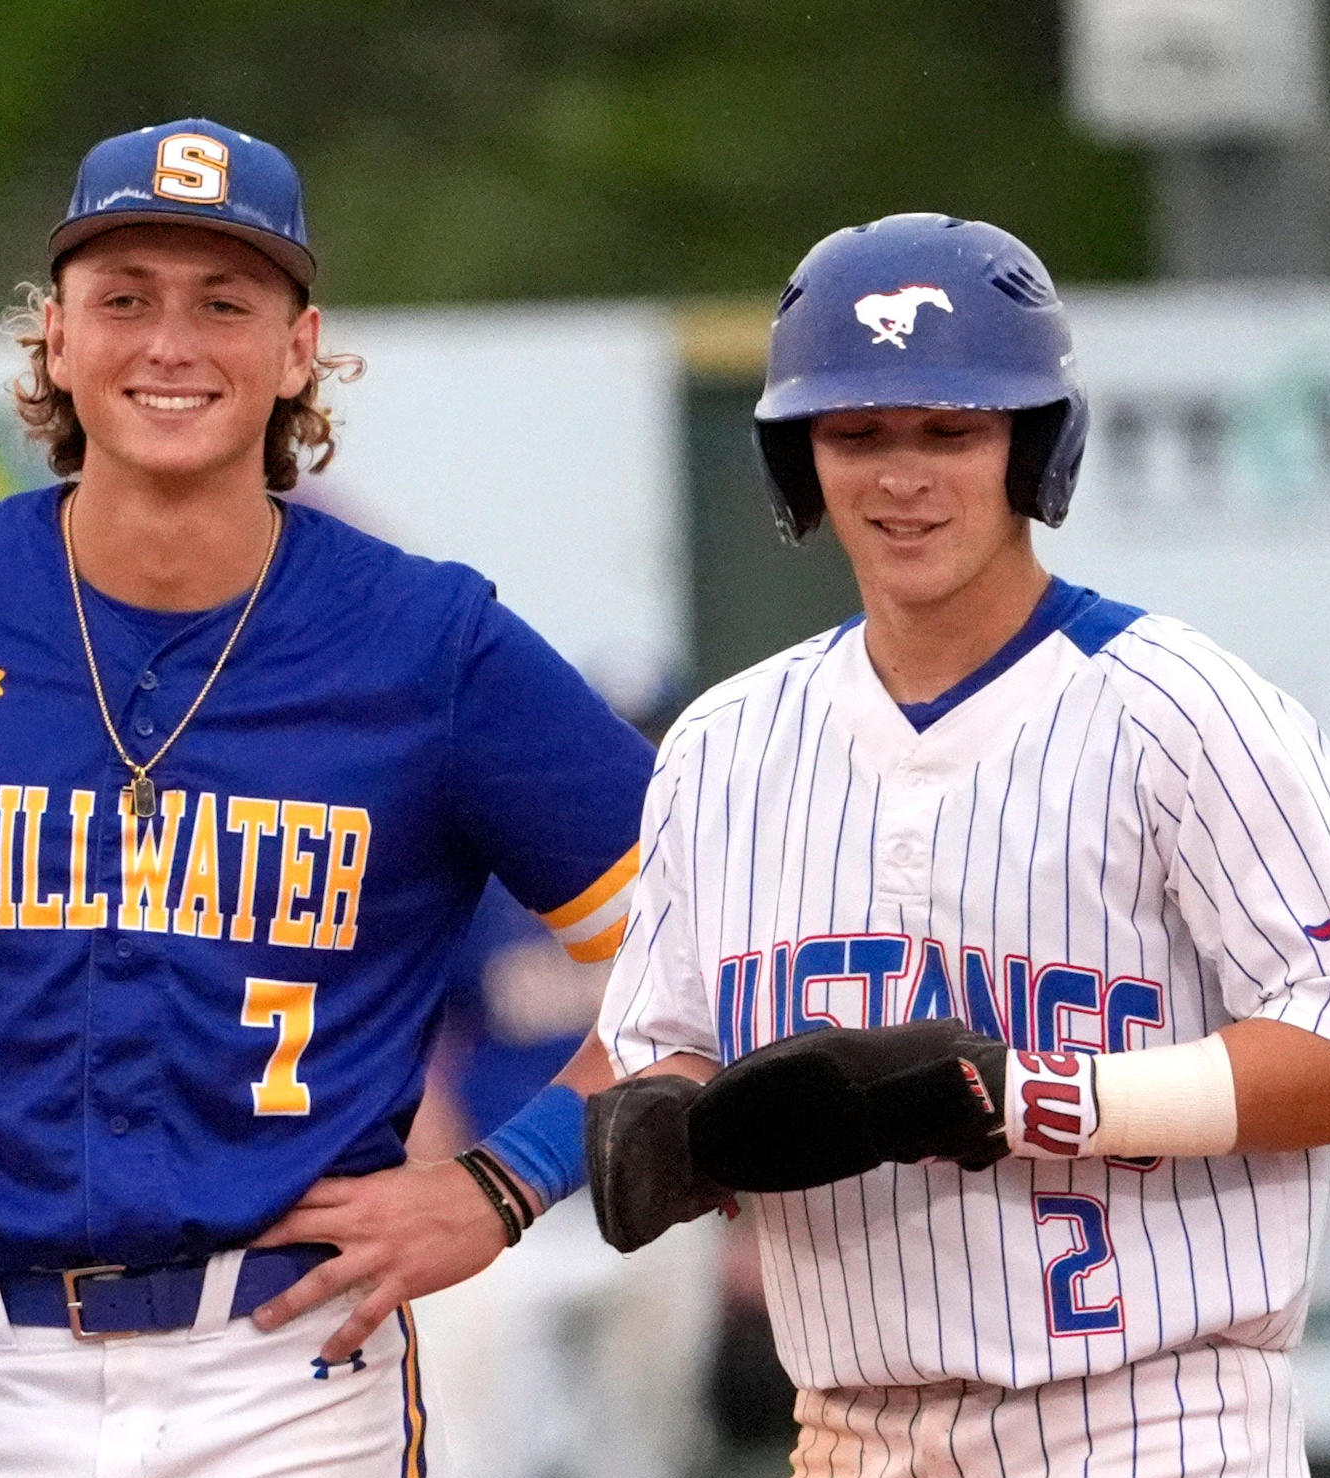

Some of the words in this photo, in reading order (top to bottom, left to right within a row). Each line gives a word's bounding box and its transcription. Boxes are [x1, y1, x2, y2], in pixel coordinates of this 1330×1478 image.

[153, 132, 229, 205] S
[240, 977, 318, 1117] 7
[1032, 1190, 1125, 1337] 2
